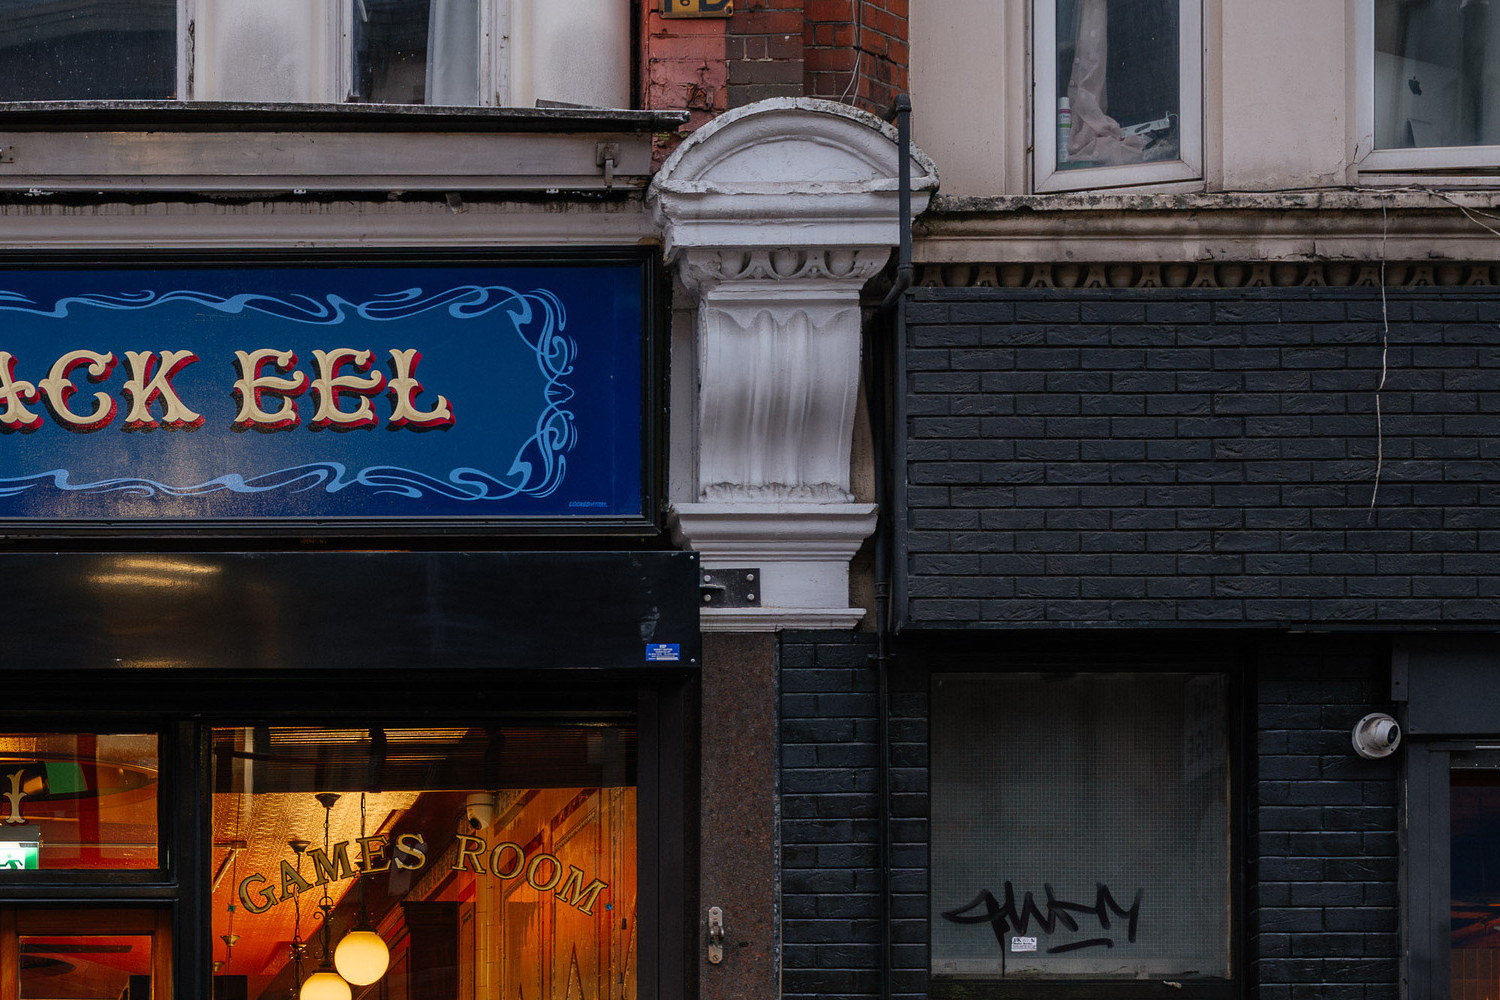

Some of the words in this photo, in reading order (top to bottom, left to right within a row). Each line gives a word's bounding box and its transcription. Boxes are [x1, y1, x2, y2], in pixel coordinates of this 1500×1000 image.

[231, 345, 455, 431] EEL
[238, 832, 427, 915] GAMES
[451, 833, 610, 916] ROOM
